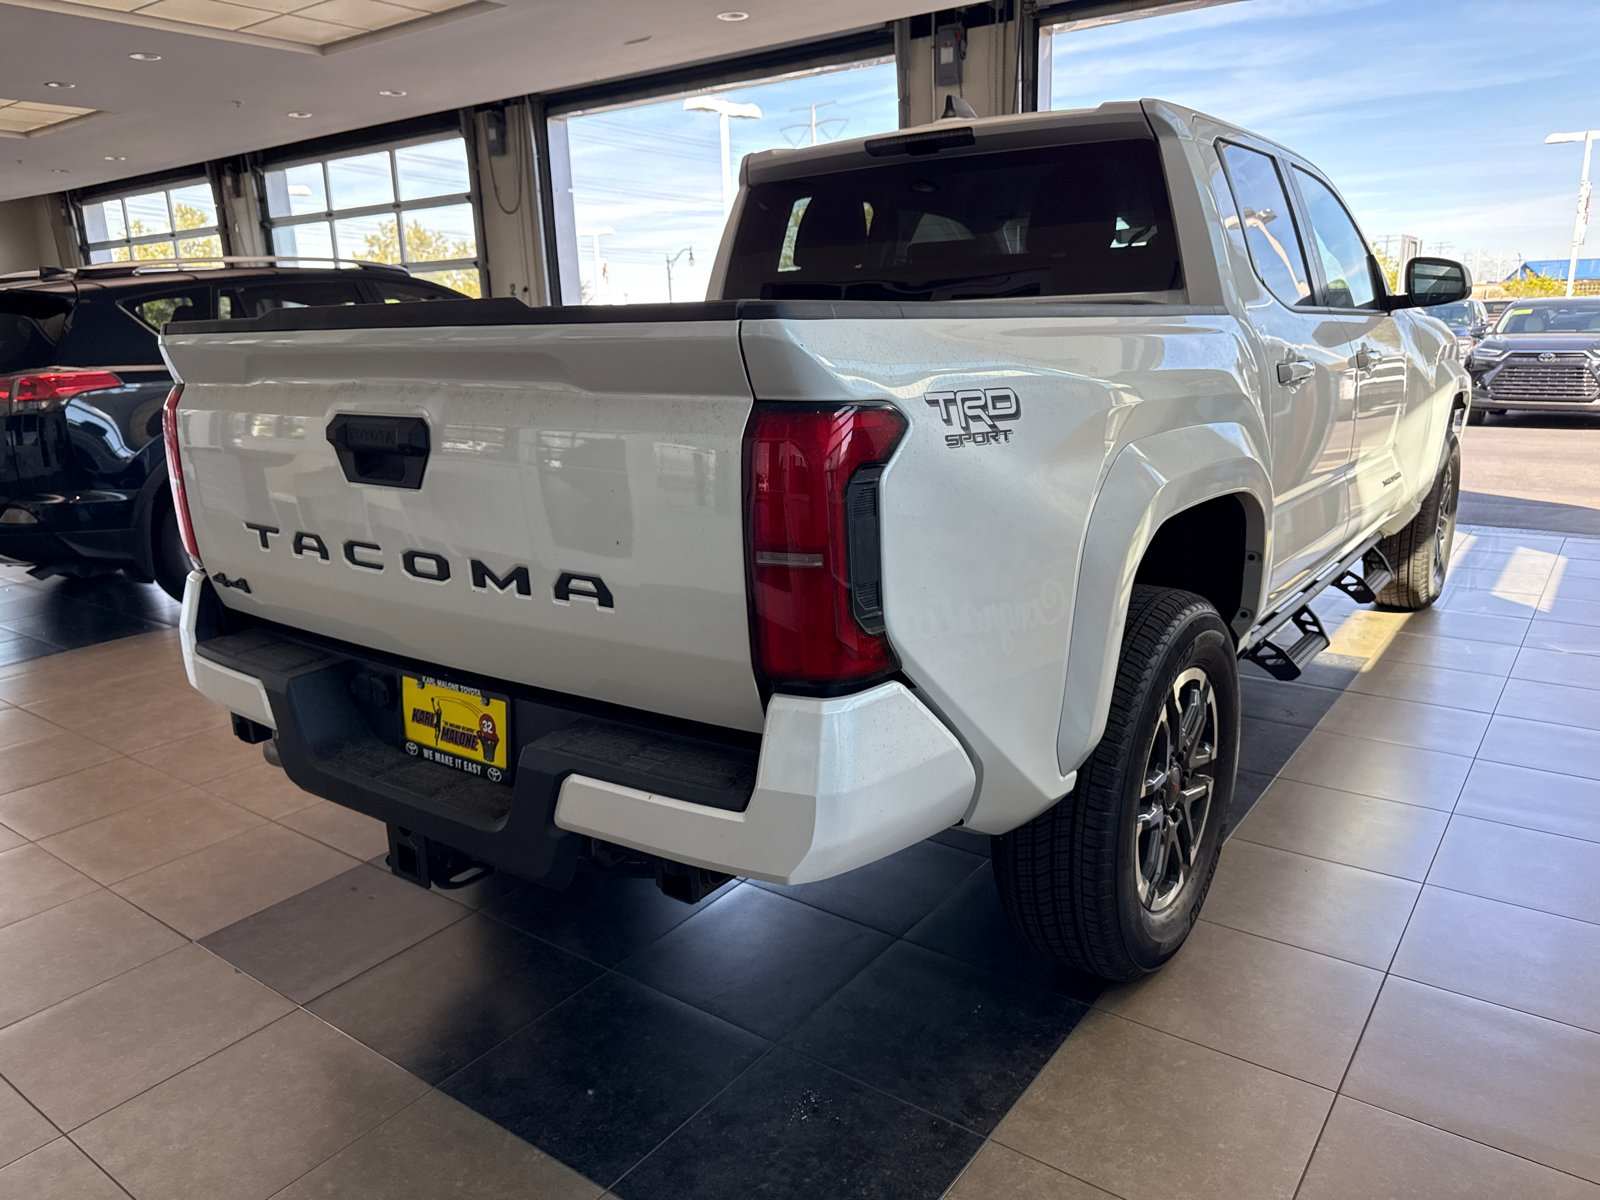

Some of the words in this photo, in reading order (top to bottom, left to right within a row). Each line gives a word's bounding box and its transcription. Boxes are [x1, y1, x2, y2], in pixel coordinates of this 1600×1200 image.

[923, 387, 1021, 434] TRD
[945, 429, 1013, 449] SPORT
[244, 522, 615, 613] TACOMA
[422, 675, 436, 686] KARL
[437, 679, 459, 692] MALONE
[460, 685, 482, 697] TOYOTA
[412, 708, 437, 728] KARL
[482, 719, 493, 734] 32
[441, 726, 479, 752] MALONE
[423, 748, 433, 760] WE
[435, 752, 453, 767] MAKE
[455, 758, 462, 769] IT
[463, 760, 481, 775] EASY
